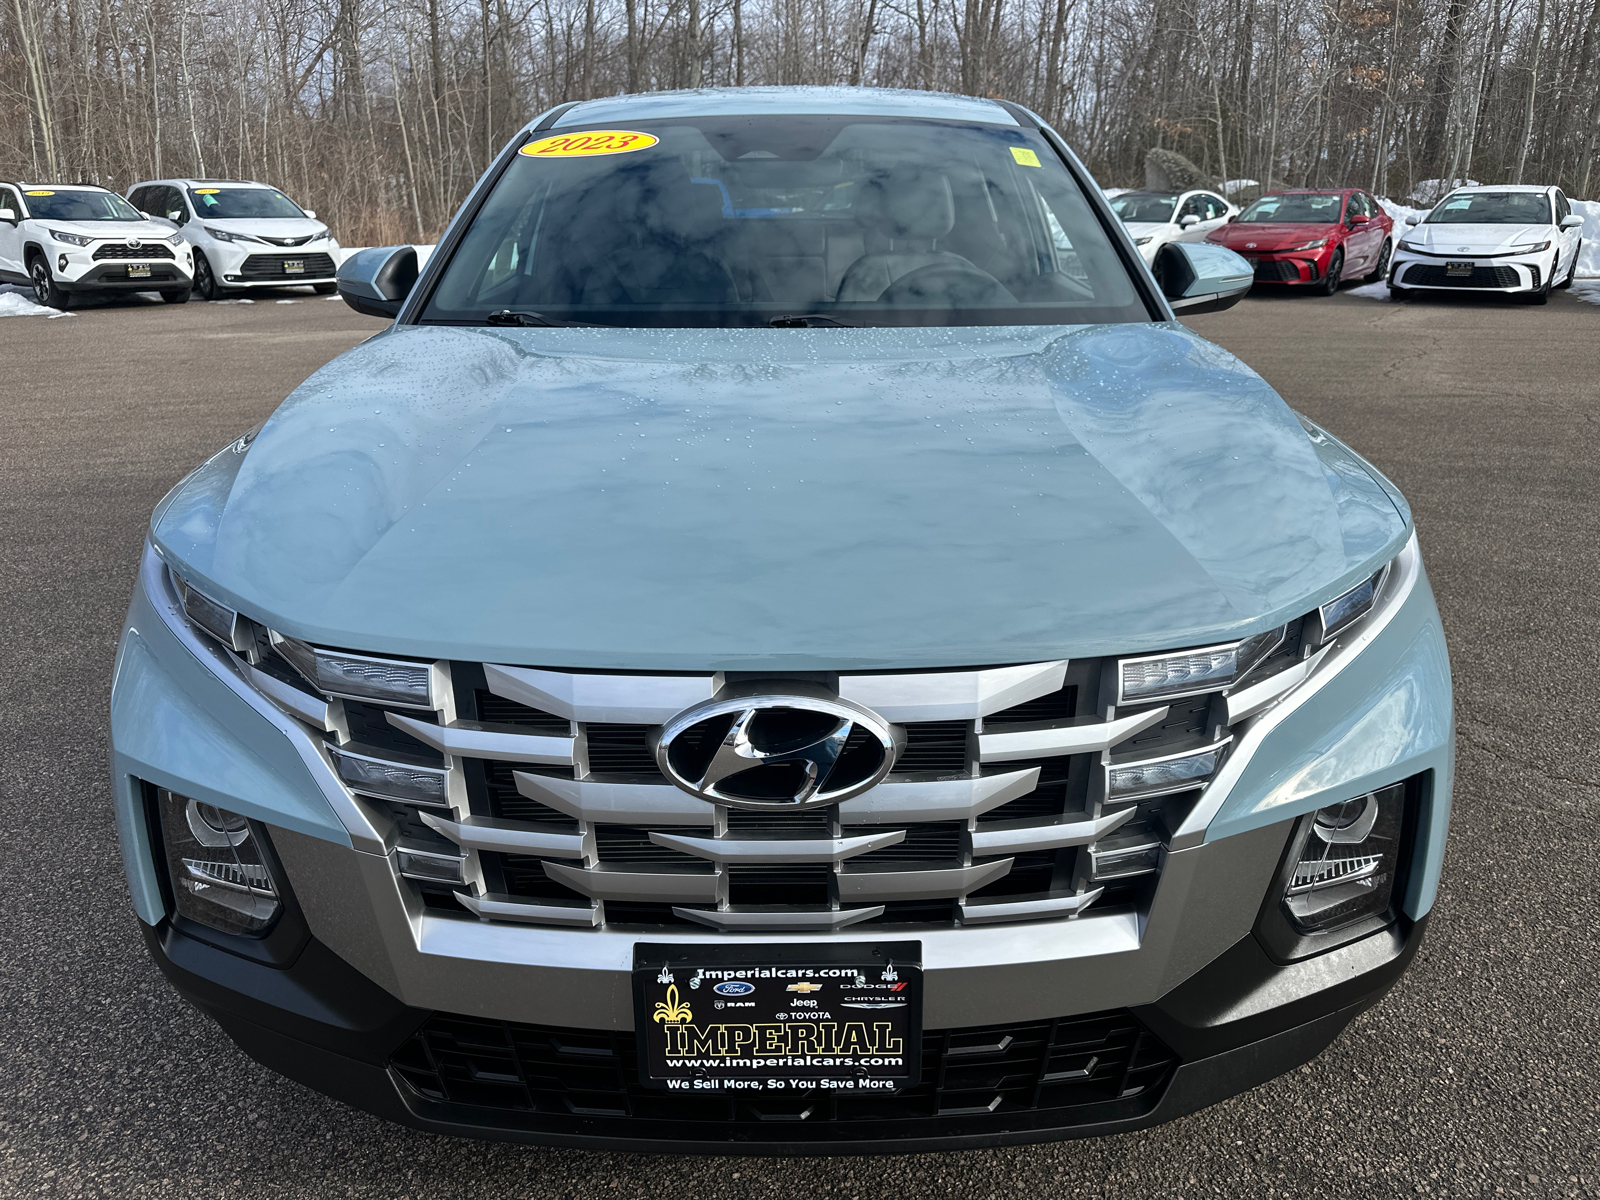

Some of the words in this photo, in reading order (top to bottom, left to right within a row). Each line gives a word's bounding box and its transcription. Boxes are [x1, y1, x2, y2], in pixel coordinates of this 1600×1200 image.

[537, 135, 639, 153] 2023
[696, 967, 858, 981] Imperialcars.com
[722, 984, 746, 993] Ford
[790, 998, 818, 1009] Jeep
[790, 1012, 831, 1020] TOYOTA
[665, 1022, 903, 1056] IMPERIAL
[666, 1056, 903, 1069] www.imperialcars.com
[666, 1079, 690, 1089] We
[693, 1079, 719, 1089] Sell
[723, 1079, 763, 1091] More,
[767, 1079, 785, 1089] So
[789, 1079, 816, 1089] You
[820, 1079, 854, 1089] Save
[858, 1078, 894, 1089] More
